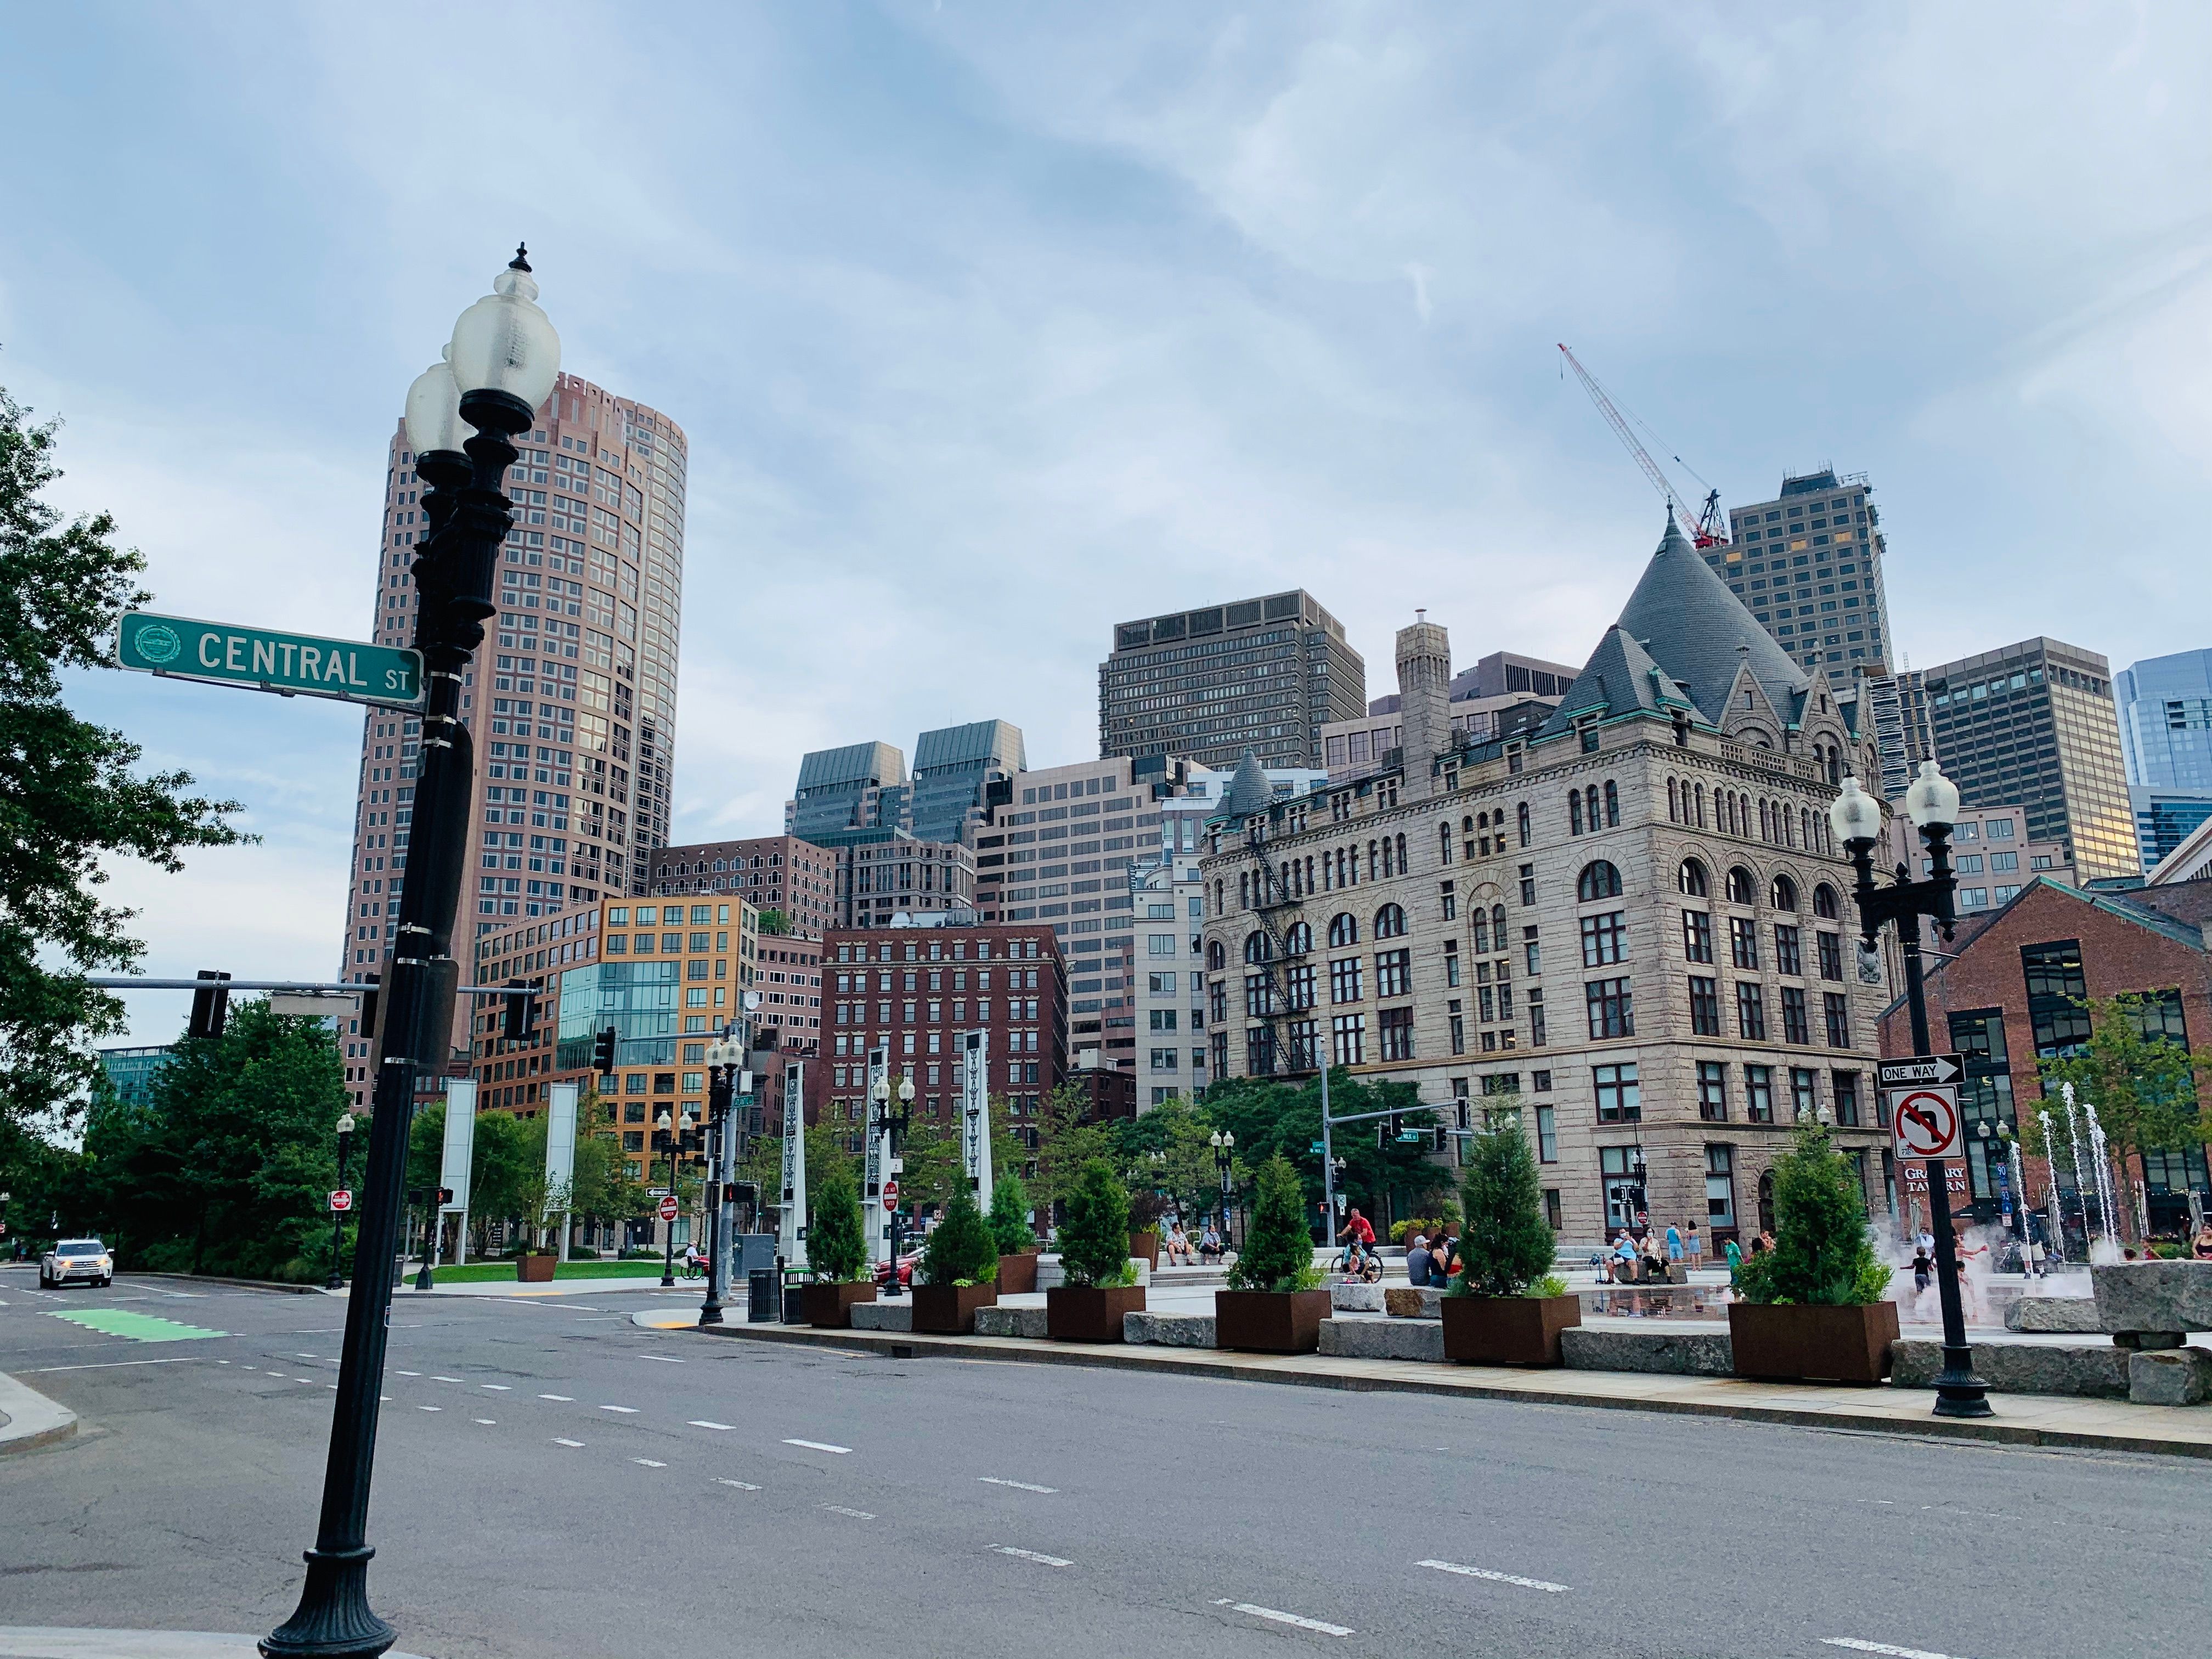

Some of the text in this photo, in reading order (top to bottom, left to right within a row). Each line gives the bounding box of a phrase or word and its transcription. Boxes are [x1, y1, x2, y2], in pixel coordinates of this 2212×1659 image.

[198, 633, 368, 686] CENTRAL
[385, 669, 410, 691] ST
[1884, 1065, 1937, 1080] ONE WAY
[1904, 1167, 1965, 1180] GRARY
[1997, 1166, 2006, 1176] 90
[1907, 1181, 1966, 1192] TAVRN
[2001, 1191, 2010, 1200] 93
